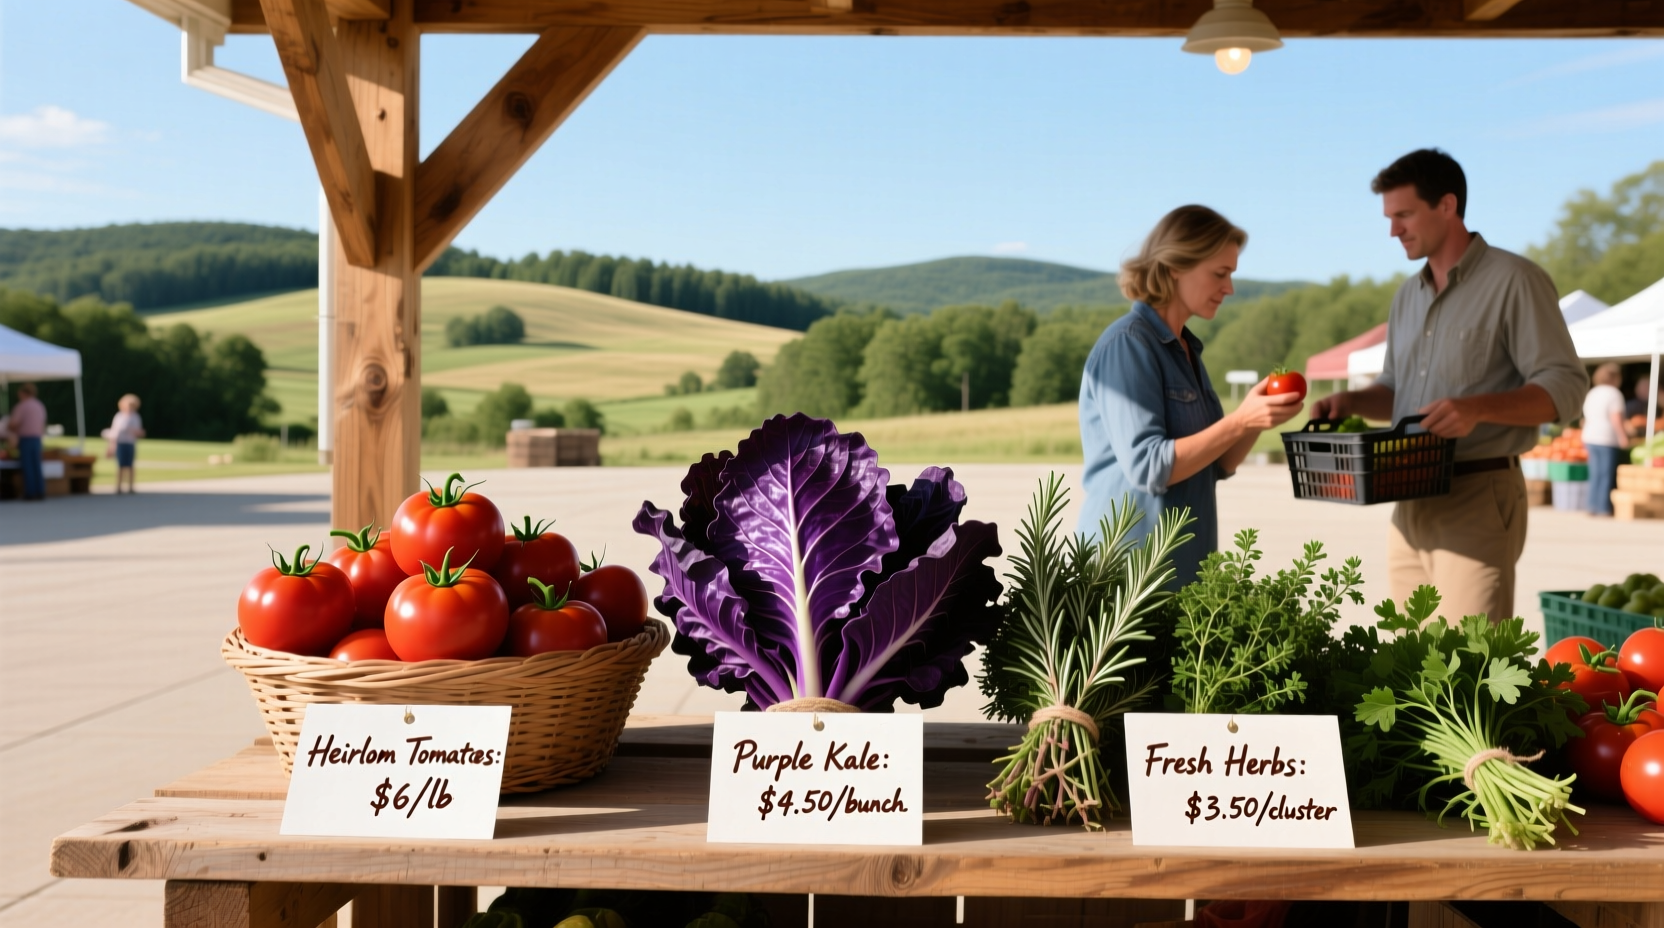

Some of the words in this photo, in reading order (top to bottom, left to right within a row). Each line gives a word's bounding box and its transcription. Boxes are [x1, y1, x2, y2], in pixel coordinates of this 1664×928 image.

[307, 734, 396, 767] Heirlom
[733, 739, 814, 782] Purple
[824, 740, 889, 772] Kale:
[1145, 742, 1213, 777] Fresh
[1224, 743, 1306, 777] Herbs:
[370, 776, 453, 819] $6/lb
[1184, 790, 1338, 827] $3.50/cluster
